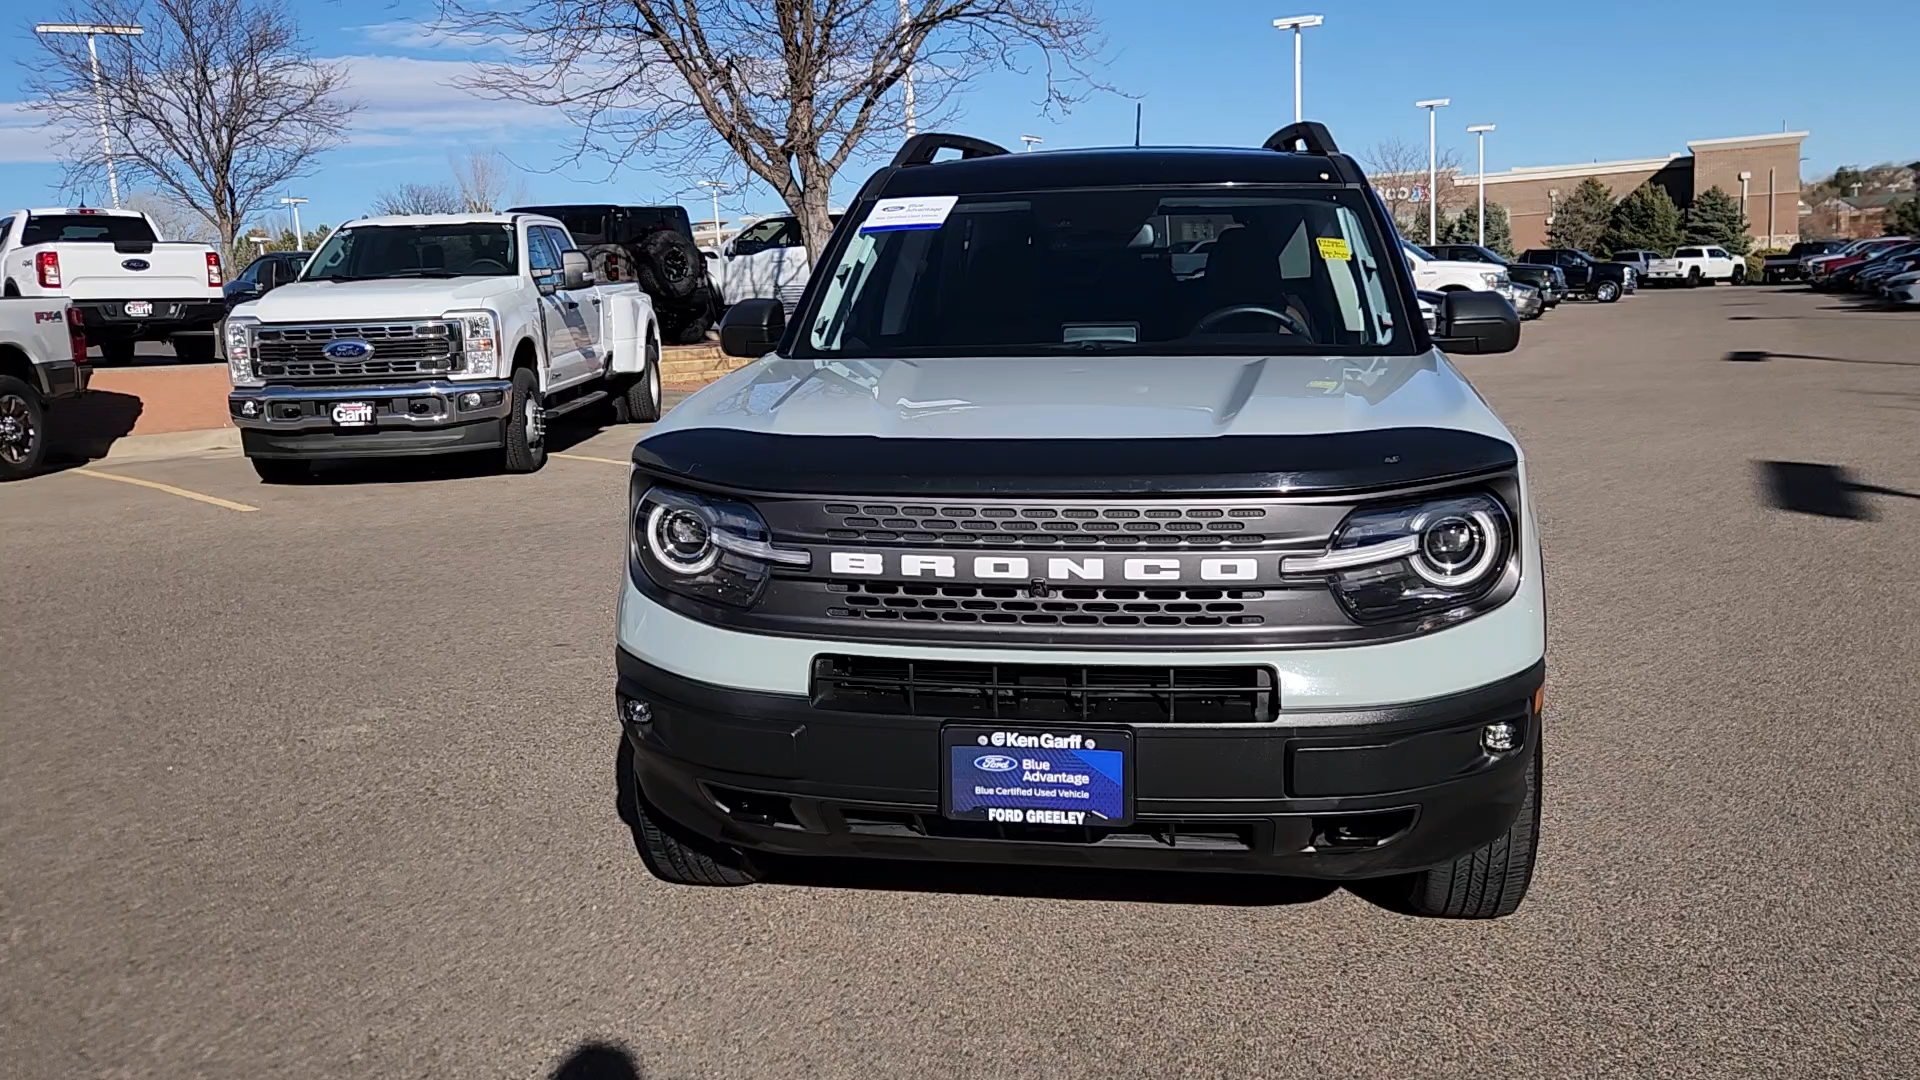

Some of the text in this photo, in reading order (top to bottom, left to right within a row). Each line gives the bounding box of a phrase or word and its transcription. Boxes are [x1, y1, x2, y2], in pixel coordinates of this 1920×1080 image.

[124, 302, 153, 315] Garff
[34, 311, 63, 324] FX4
[335, 345, 360, 356] Ford
[332, 405, 372, 422] Garff
[830, 552, 1258, 581] BRONCO
[1006, 732, 1039, 747] Ken
[1040, 733, 1082, 749] Garff
[981, 756, 1010, 769] Ford
[1022, 759, 1050, 771] Blue
[1022, 771, 1089, 785] Advantage
[975, 786, 1089, 799] Blue Certified Used Vehicle
[988, 808, 1086, 825] FORD GREELEY
